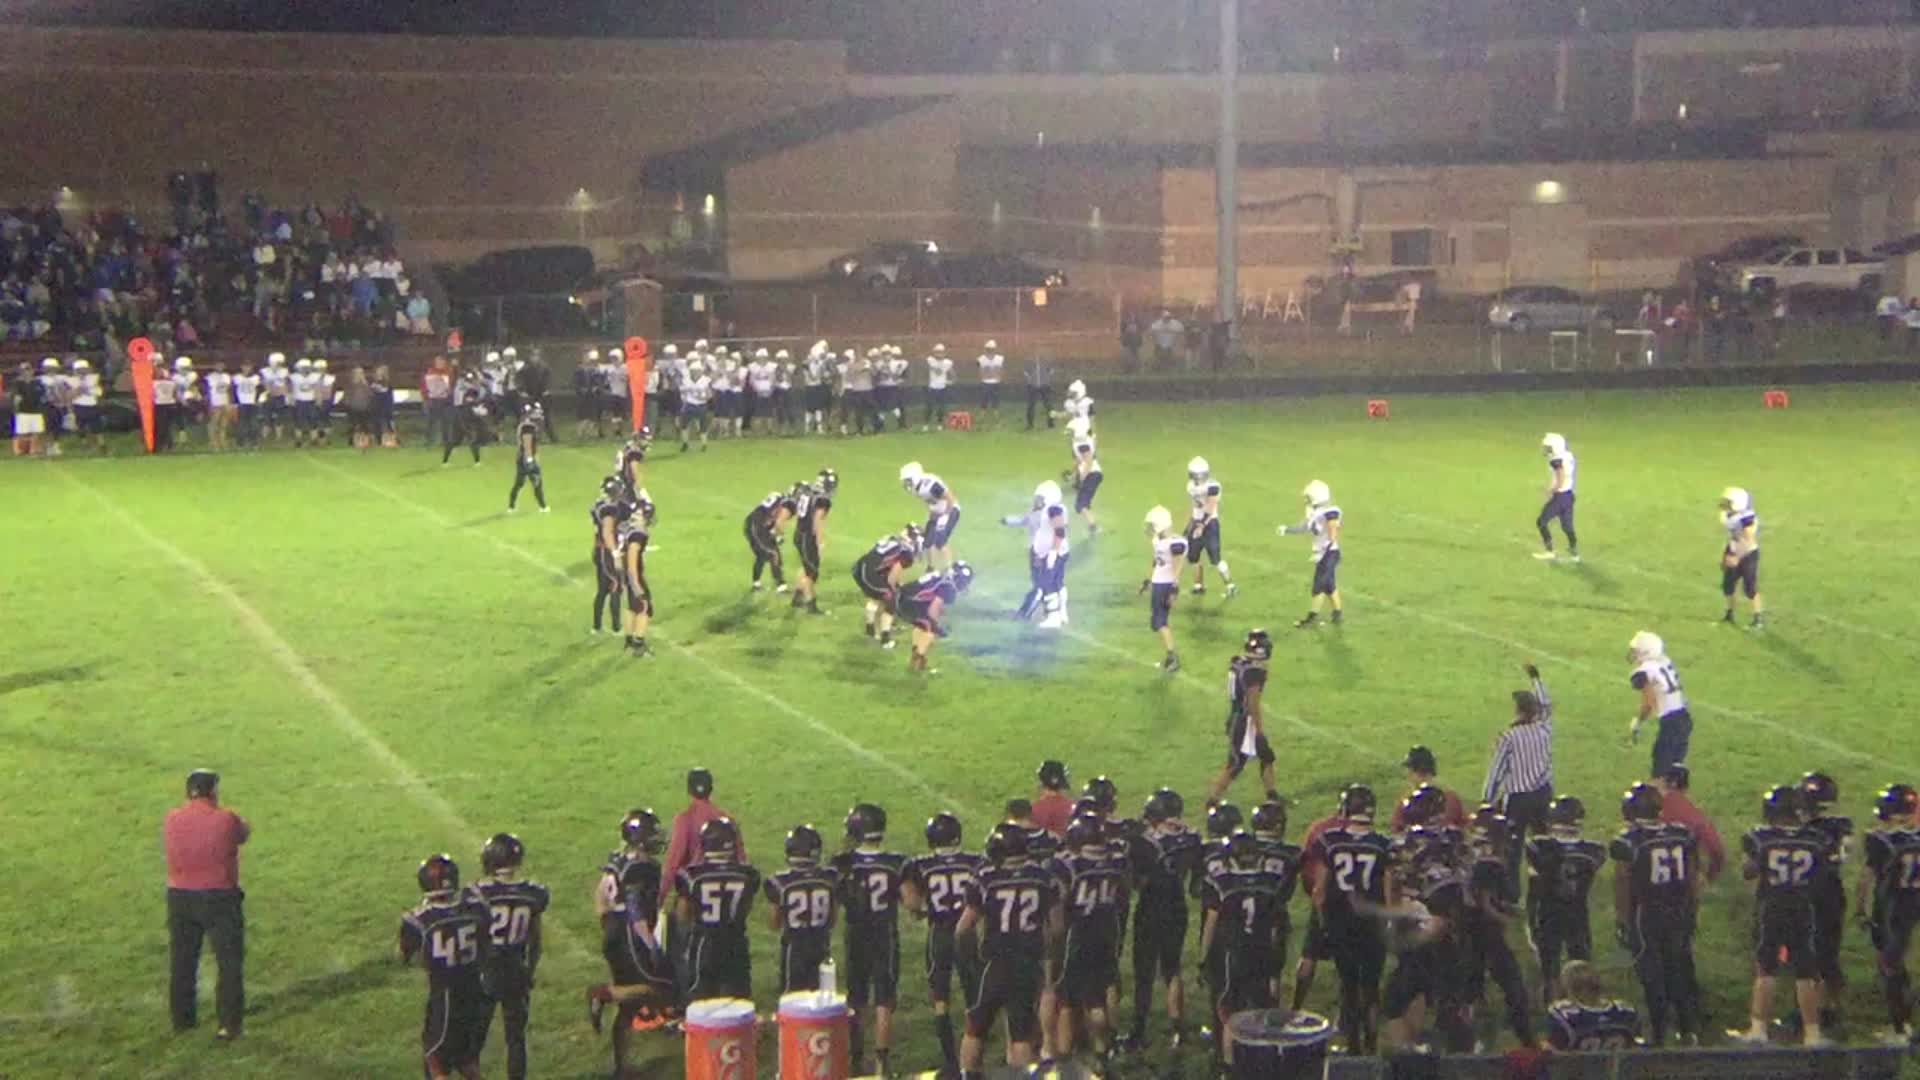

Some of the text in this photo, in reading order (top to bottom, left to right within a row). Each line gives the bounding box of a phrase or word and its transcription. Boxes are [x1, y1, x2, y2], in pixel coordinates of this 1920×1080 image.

[1333, 852, 1375, 891] 27
[1651, 846, 1683, 884] 61
[1767, 849, 1811, 887] 52
[701, 881, 744, 923] 57
[787, 889, 829, 929] 28
[868, 872, 888, 912] 2
[929, 872, 971, 912] 25
[997, 890, 1039, 933] 72
[1075, 879, 1118, 916] 44
[488, 905, 530, 945] 20
[431, 925, 477, 966] 45
